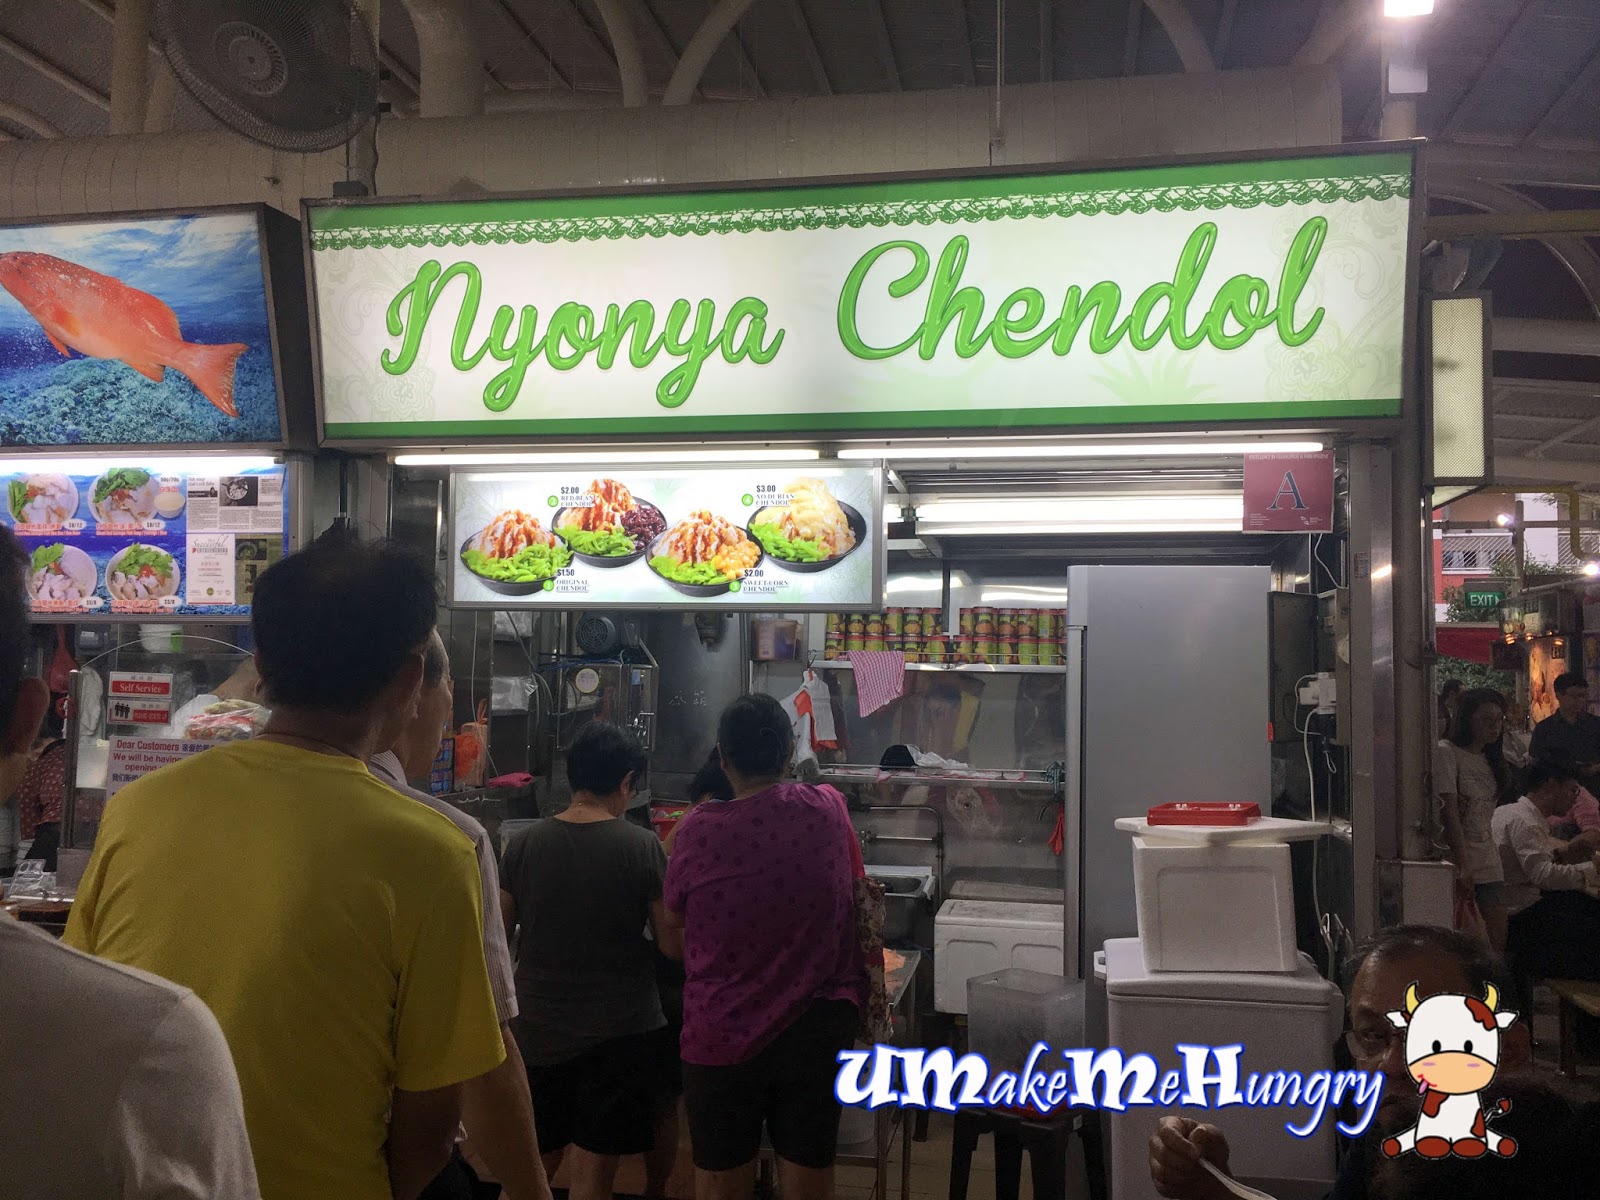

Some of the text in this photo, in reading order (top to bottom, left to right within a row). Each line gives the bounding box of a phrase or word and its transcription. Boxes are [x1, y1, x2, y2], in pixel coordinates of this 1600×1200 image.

[381, 216, 1328, 412] Nyonya Chendol
[560, 486, 580, 494] $2.00
[756, 484, 776, 493] $3.00
[1266, 470, 1310, 510] A
[557, 568, 575, 577] $1.50
[744, 569, 764, 577] $2.00
[1470, 595, 1494, 606] EXIT
[119, 682, 162, 694] Self Service
[116, 739, 180, 751] Dear Customers
[113, 752, 127, 761] We
[128, 754, 142, 762] will
[144, 754, 154, 763] be
